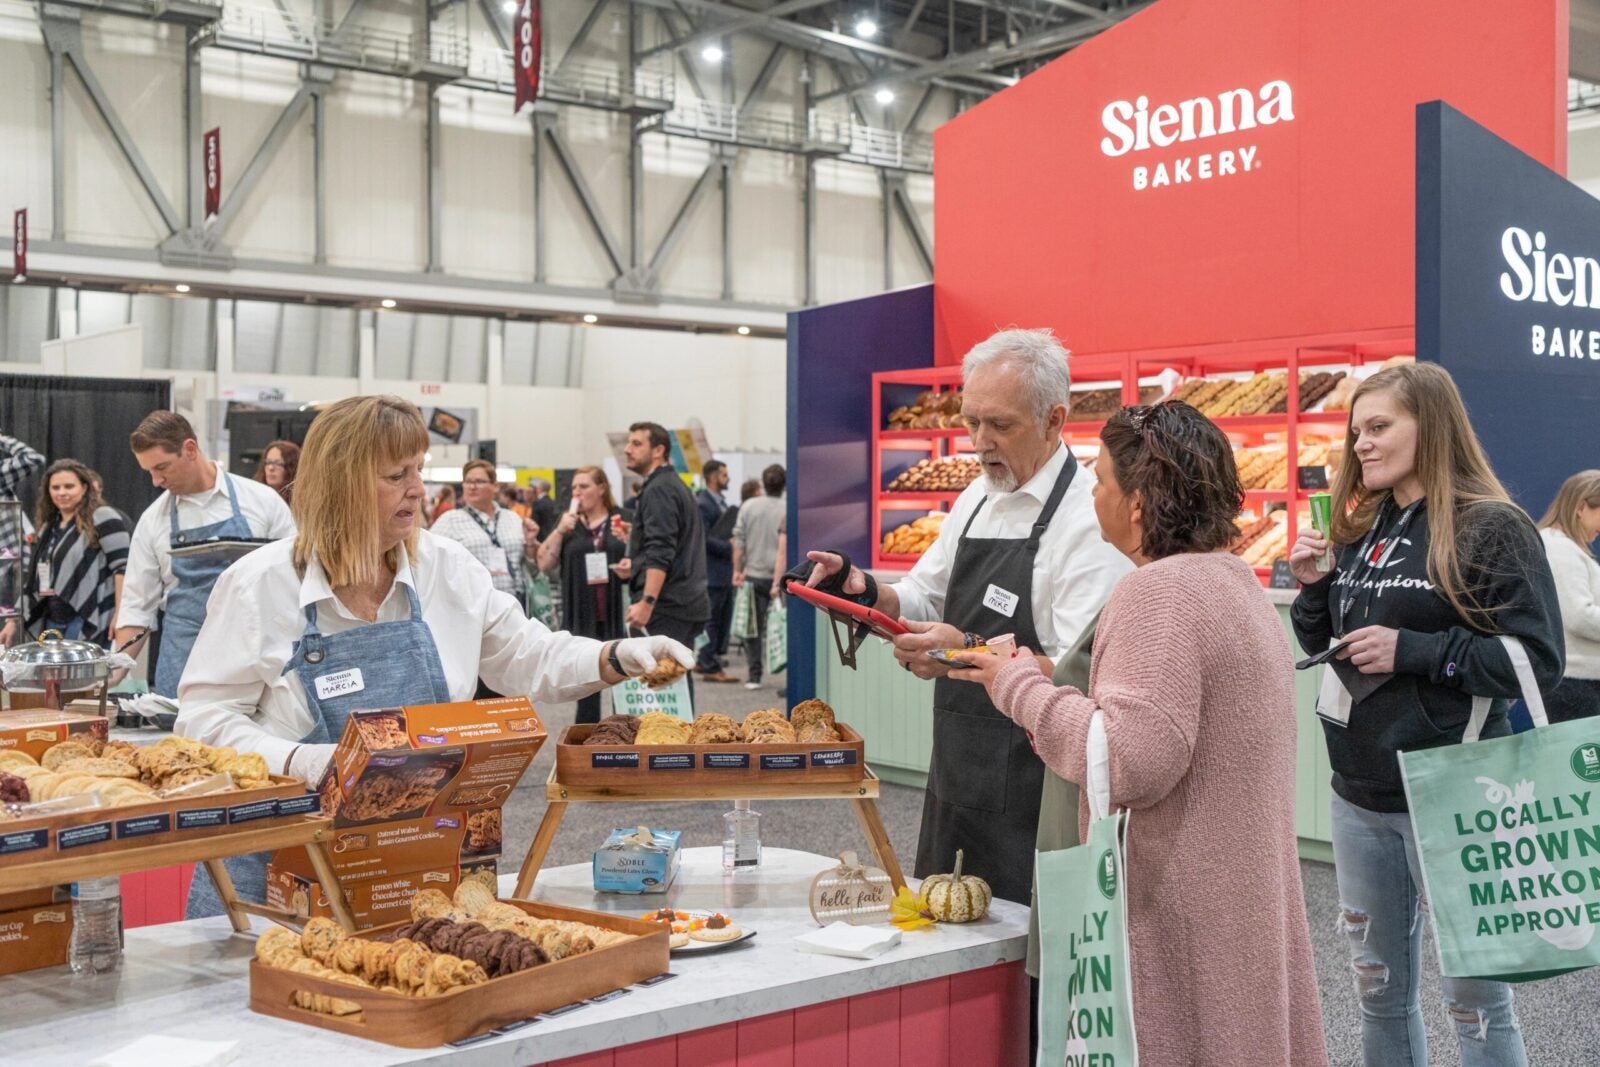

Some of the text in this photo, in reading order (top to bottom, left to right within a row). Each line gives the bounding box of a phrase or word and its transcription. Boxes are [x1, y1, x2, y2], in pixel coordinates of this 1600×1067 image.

[1101, 79, 1295, 157] Sienna
[1133, 146, 1258, 191] BAKERY
[322, 681, 358, 694] MARCIA
[626, 693, 677, 704] GROWN
[1454, 791, 1592, 836] LOCALLY
[1460, 824, 1600, 873] GROWN
[372, 880, 411, 892] Lemon White
[371, 890, 400, 901] Chocolate
[371, 900, 399, 910] Gourmet
